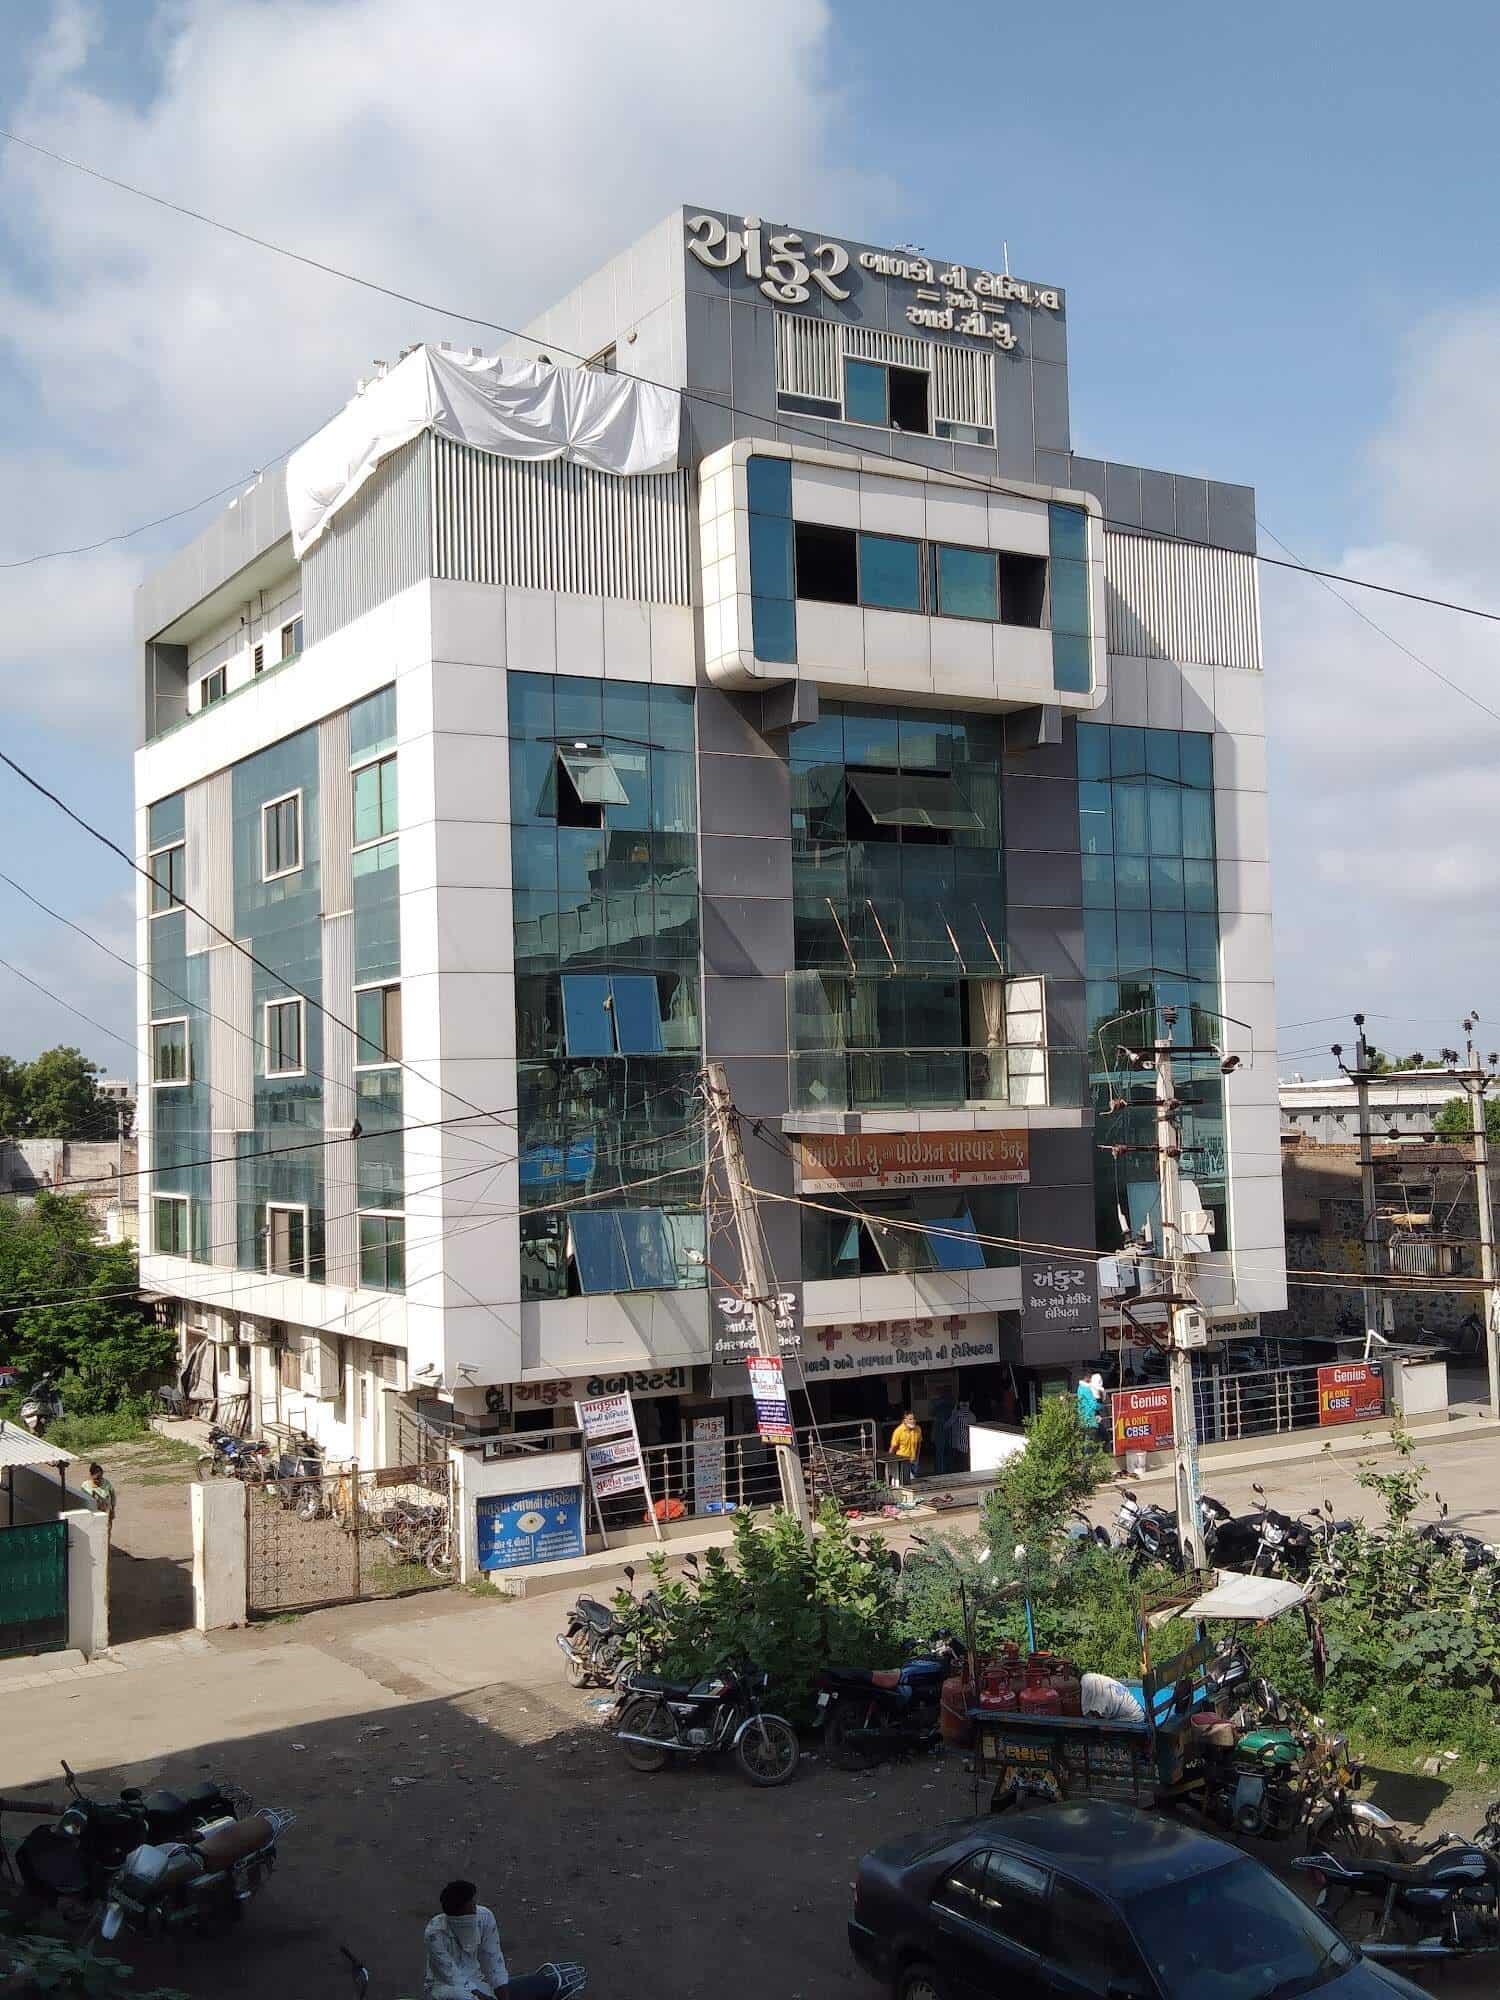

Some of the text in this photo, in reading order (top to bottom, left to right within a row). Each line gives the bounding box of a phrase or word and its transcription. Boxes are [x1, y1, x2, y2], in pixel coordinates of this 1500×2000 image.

[687, 215, 851, 304] અંકુર
[859, 252, 935, 284] બાળકો
[940, 265, 969, 292] ની
[945, 290, 979, 311] અને
[948, 1139, 995, 1163] સારવાર
[1032, 1265, 1086, 1292] અંકુર
[1048, 1295, 1065, 1306] અને
[834, 1353, 855, 1370] અને
[936, 1344, 949, 1361] ની
[1334, 1368, 1367, 1383] Genius
[1130, 1391, 1168, 1409] Genius
[1330, 1397, 1351, 1409] CBSE
[1126, 1425, 1150, 1438] CBSE
